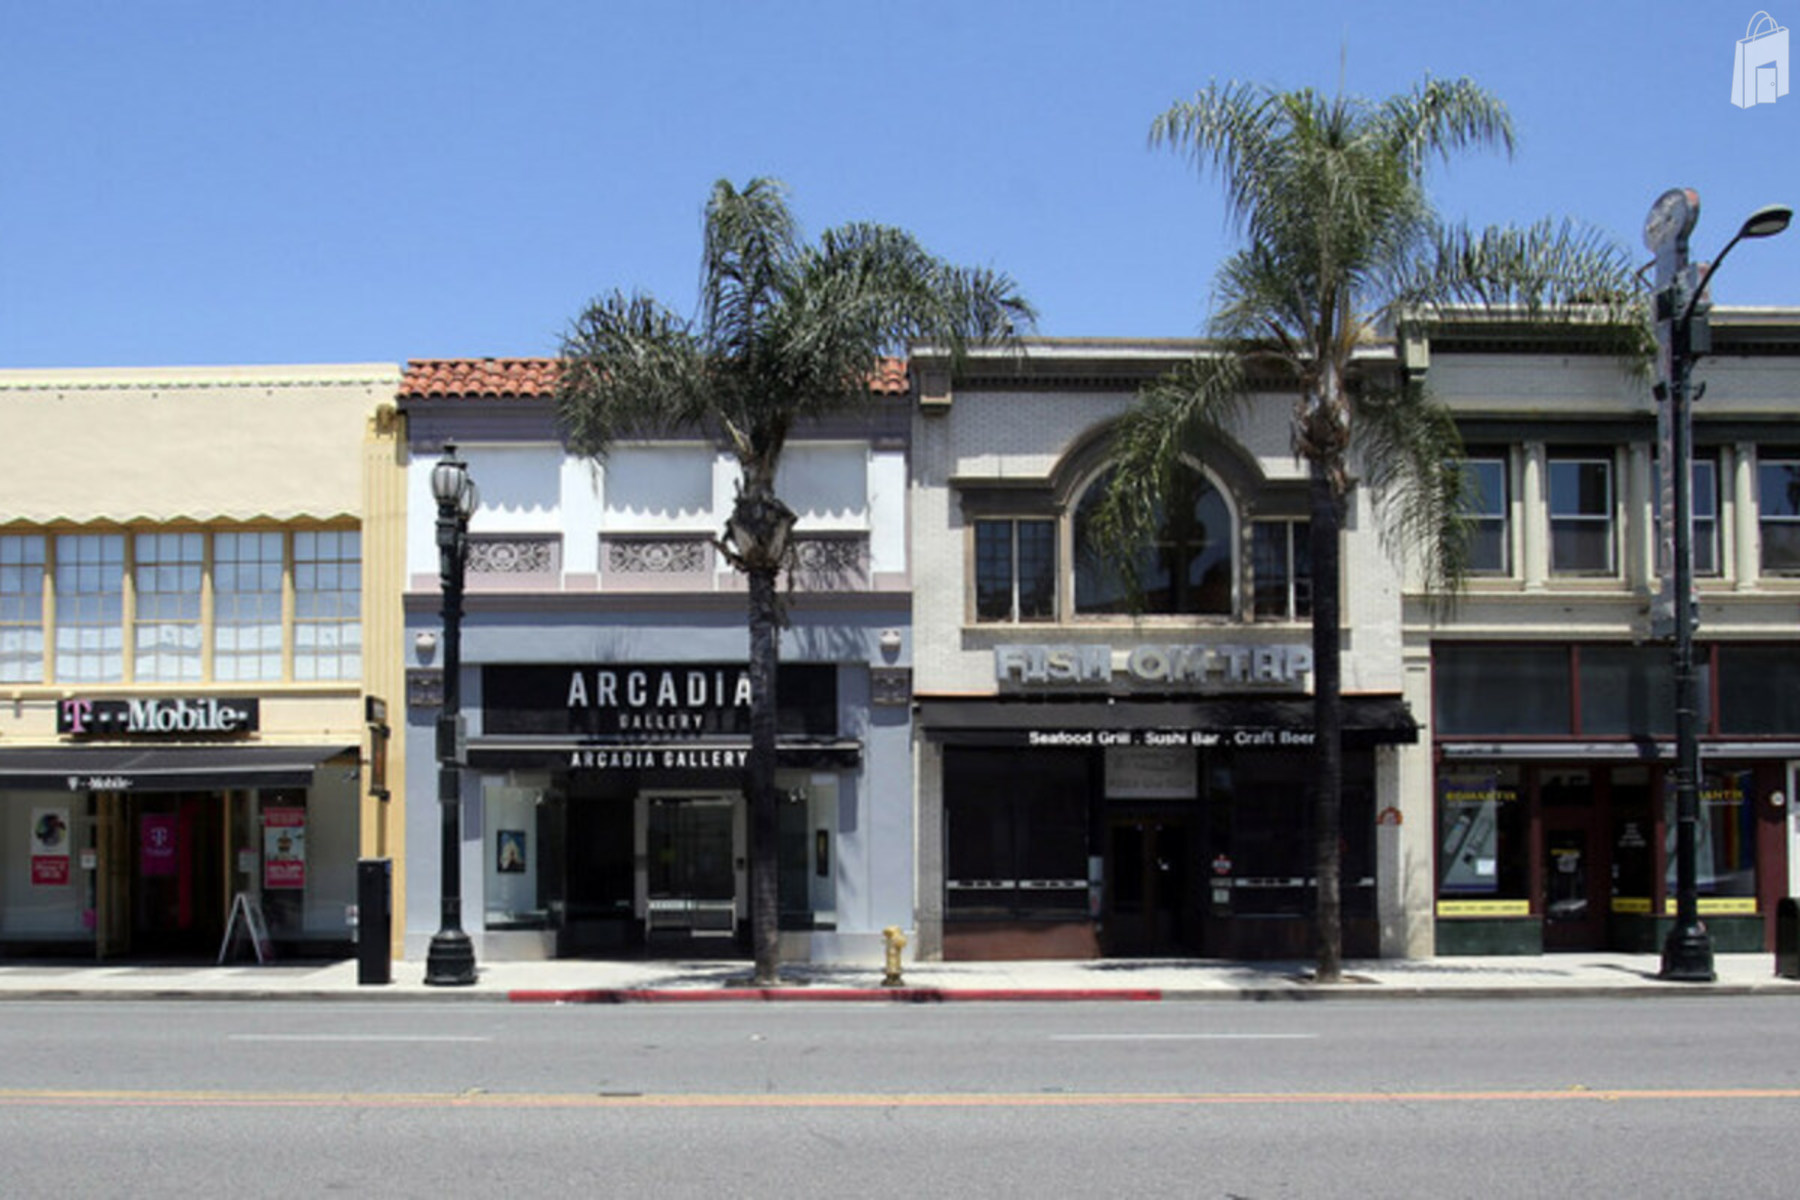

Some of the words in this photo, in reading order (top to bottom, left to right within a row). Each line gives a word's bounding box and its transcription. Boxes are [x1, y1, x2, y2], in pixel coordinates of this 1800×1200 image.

[994, 644, 1112, 682] FISH
[1128, 644, 1207, 682] ON
[1220, 644, 1314, 682] TAP
[568, 671, 752, 707] ARCADIA
[618, 713, 703, 730] GALLERY
[1028, 730, 1094, 745] Seafood
[1097, 730, 1131, 745] Grill
[1144, 730, 1189, 745] Sushi
[1191, 731, 1220, 745] Bar
[1233, 730, 1275, 745] Craft
[1279, 731, 1316, 745] Beer
[570, 750, 655, 768] ARCADIA
[663, 750, 748, 768] GALLERY
